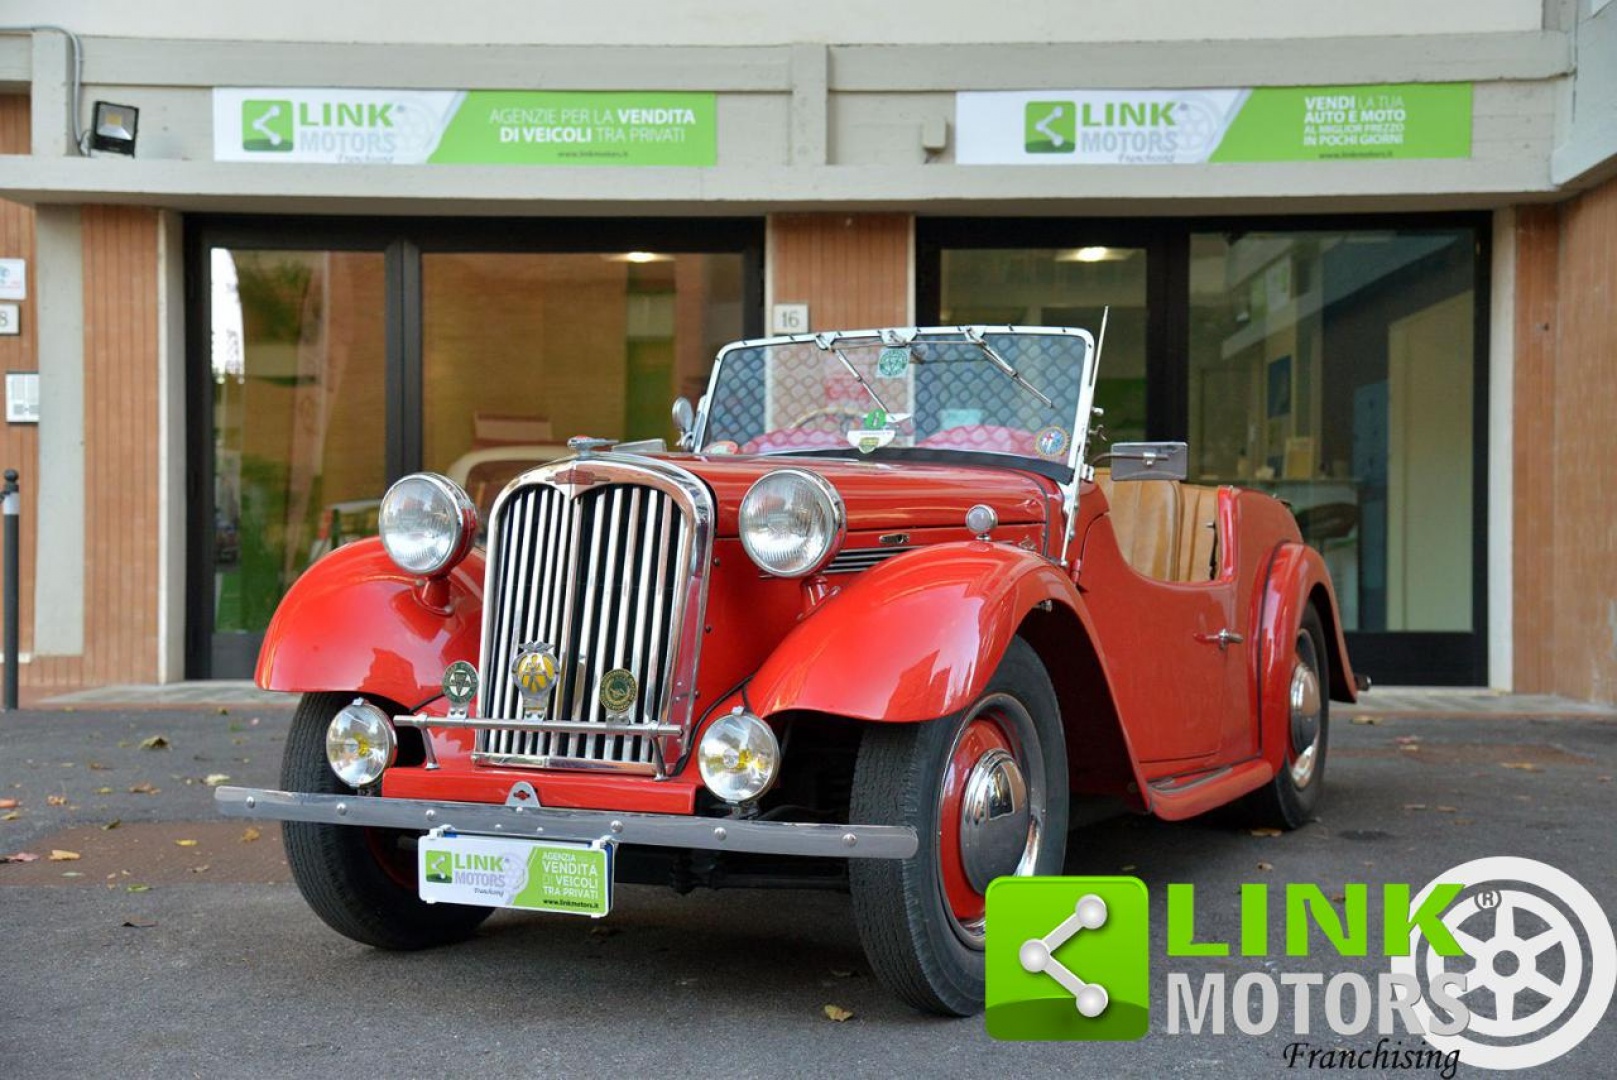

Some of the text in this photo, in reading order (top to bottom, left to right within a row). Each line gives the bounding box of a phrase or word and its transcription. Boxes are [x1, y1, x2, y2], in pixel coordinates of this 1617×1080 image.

[1304, 96, 1355, 110] VENDI
[1379, 96, 1405, 108] TUA
[299, 102, 393, 127] LINK
[490, 109, 696, 124] AGENZIE PER LA VENDITA
[1082, 102, 1176, 126] LINK
[1304, 109, 1406, 124] AUTO E MOTO
[300, 131, 397, 153] MOTORS
[500, 127, 686, 142] DI VEICOLI TRA PRIVATI
[1082, 131, 1179, 152] MOTORS
[782, 310, 800, 328] 16
[454, 853, 503, 872] LINK
[542, 861, 598, 876] VENDITA
[454, 870, 506, 888] MOTORS
[555, 875, 599, 889] VEICOLI
[543, 886, 599, 899] TRA PRIVATI
